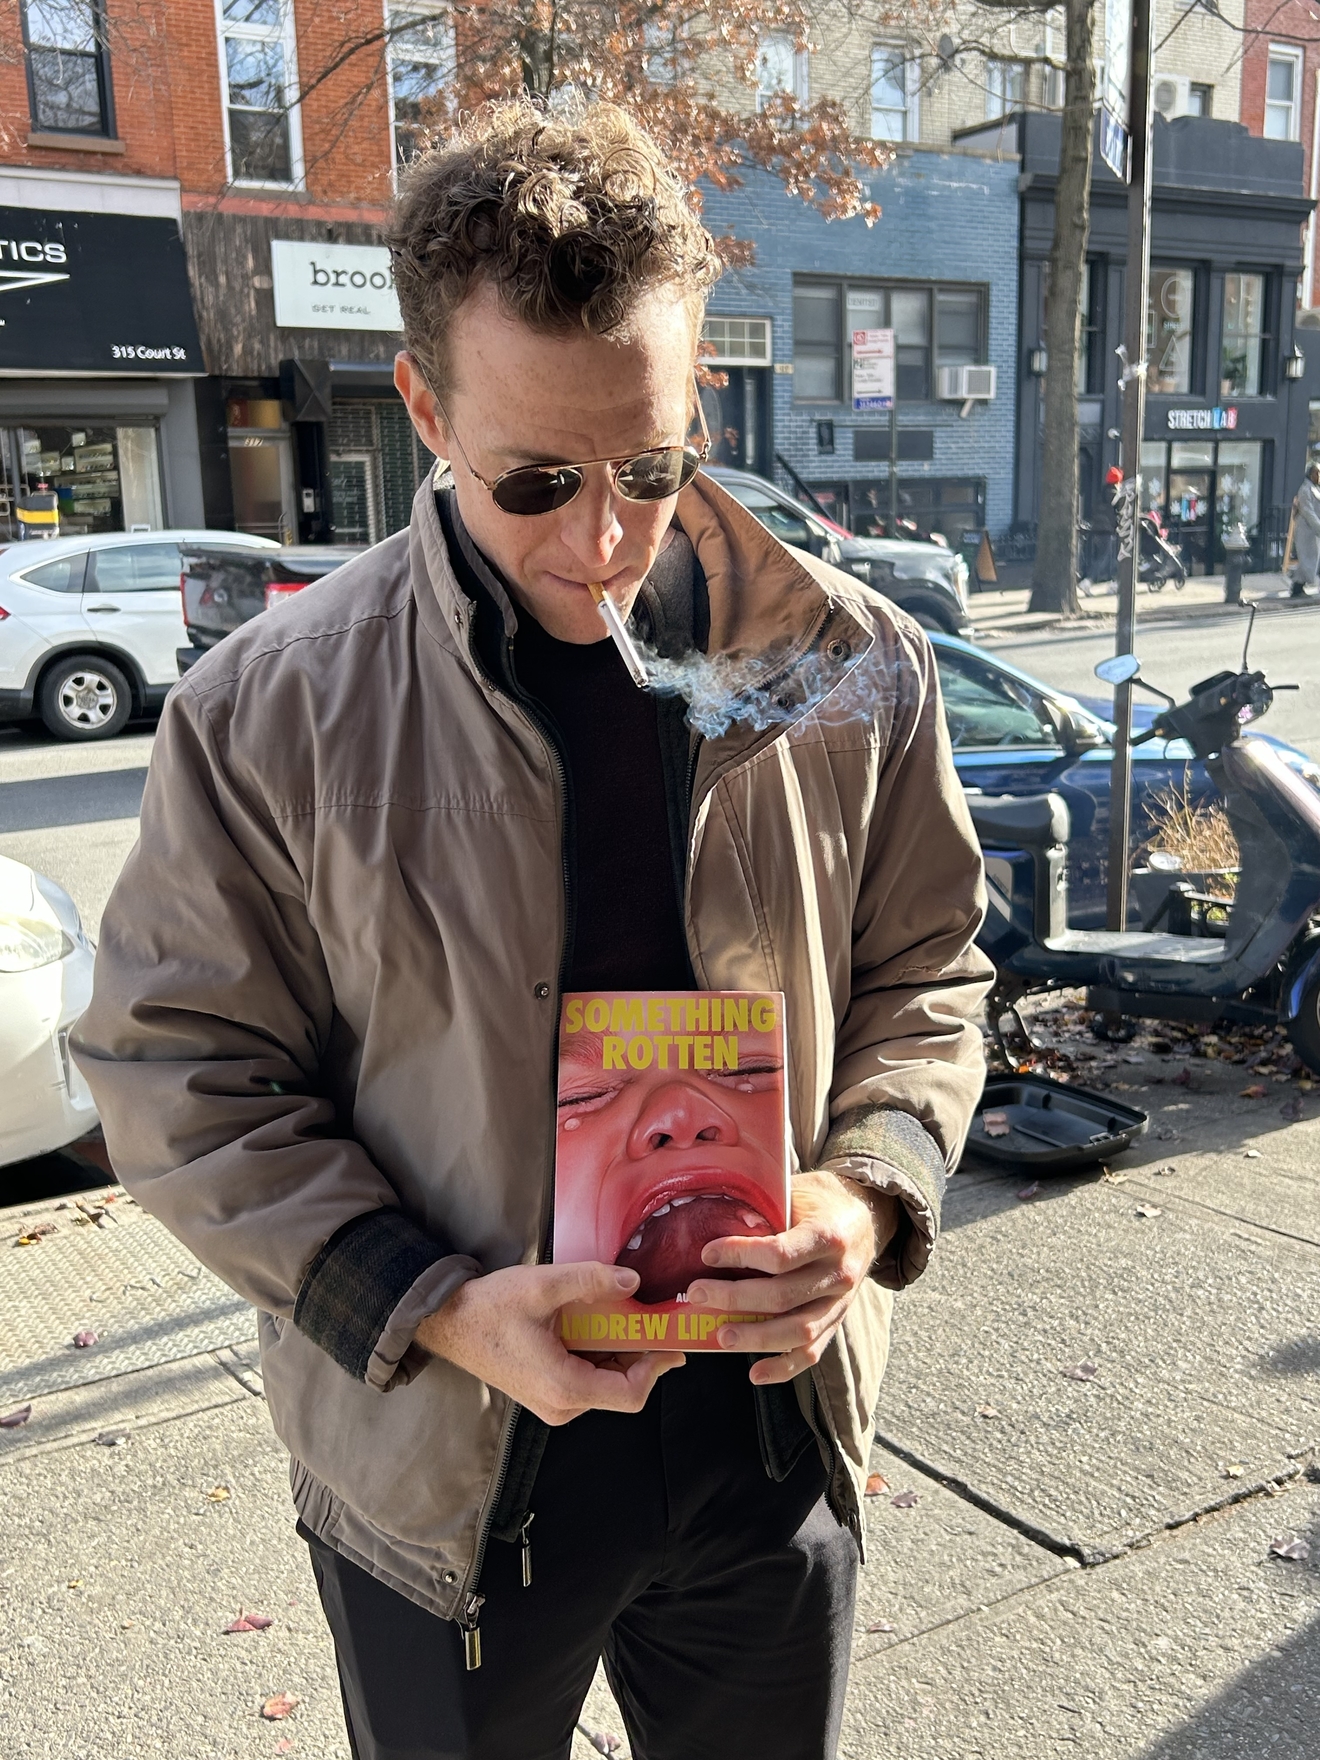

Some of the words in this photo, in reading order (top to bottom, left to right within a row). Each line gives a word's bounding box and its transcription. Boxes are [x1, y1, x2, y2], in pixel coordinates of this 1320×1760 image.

[340, 305, 371, 315] REAL
[111, 345, 135, 359] 315
[136, 346, 172, 360] Court
[172, 347, 187, 360] St
[1167, 409, 1211, 430] STRETCH
[565, 998, 777, 1034] SOMETHING
[602, 1035, 738, 1070] ROTTEN
[562, 1313, 670, 1341] ANDREW
